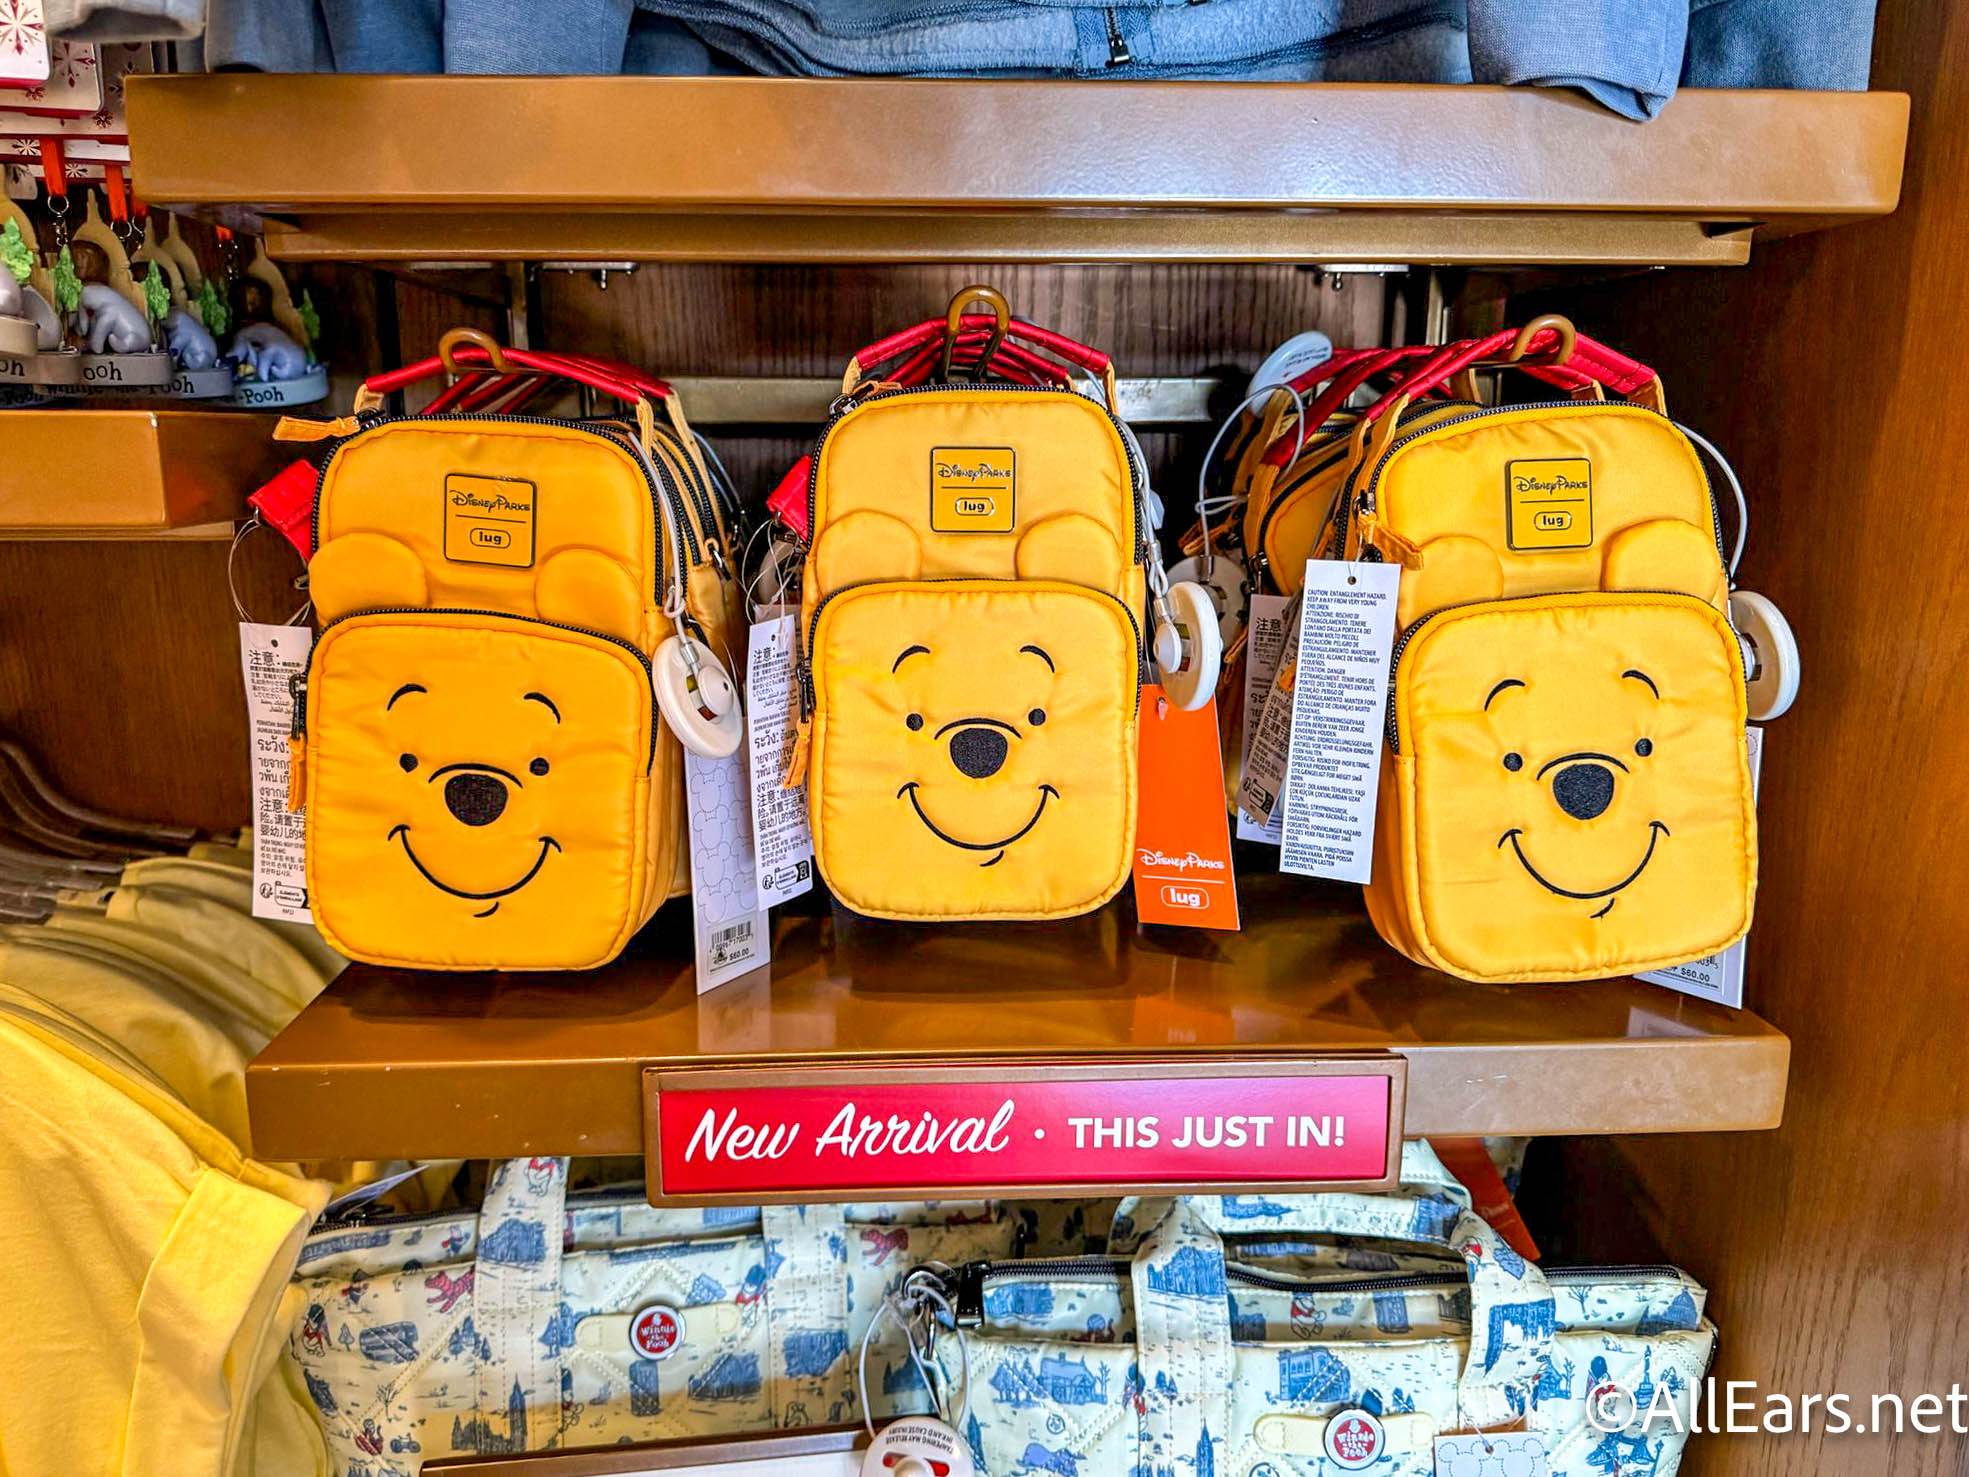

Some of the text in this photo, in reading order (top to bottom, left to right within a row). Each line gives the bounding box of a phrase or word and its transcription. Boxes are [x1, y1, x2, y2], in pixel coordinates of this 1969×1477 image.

[963, 500, 985, 512] lug
[1542, 514, 1564, 527] lug
[478, 531, 502, 545] lug
[1169, 887, 1200, 907] lug
[1681, 967, 1711, 982] $60.00
[684, 1098, 1345, 1163] New Arrival THIS JUST IN!
